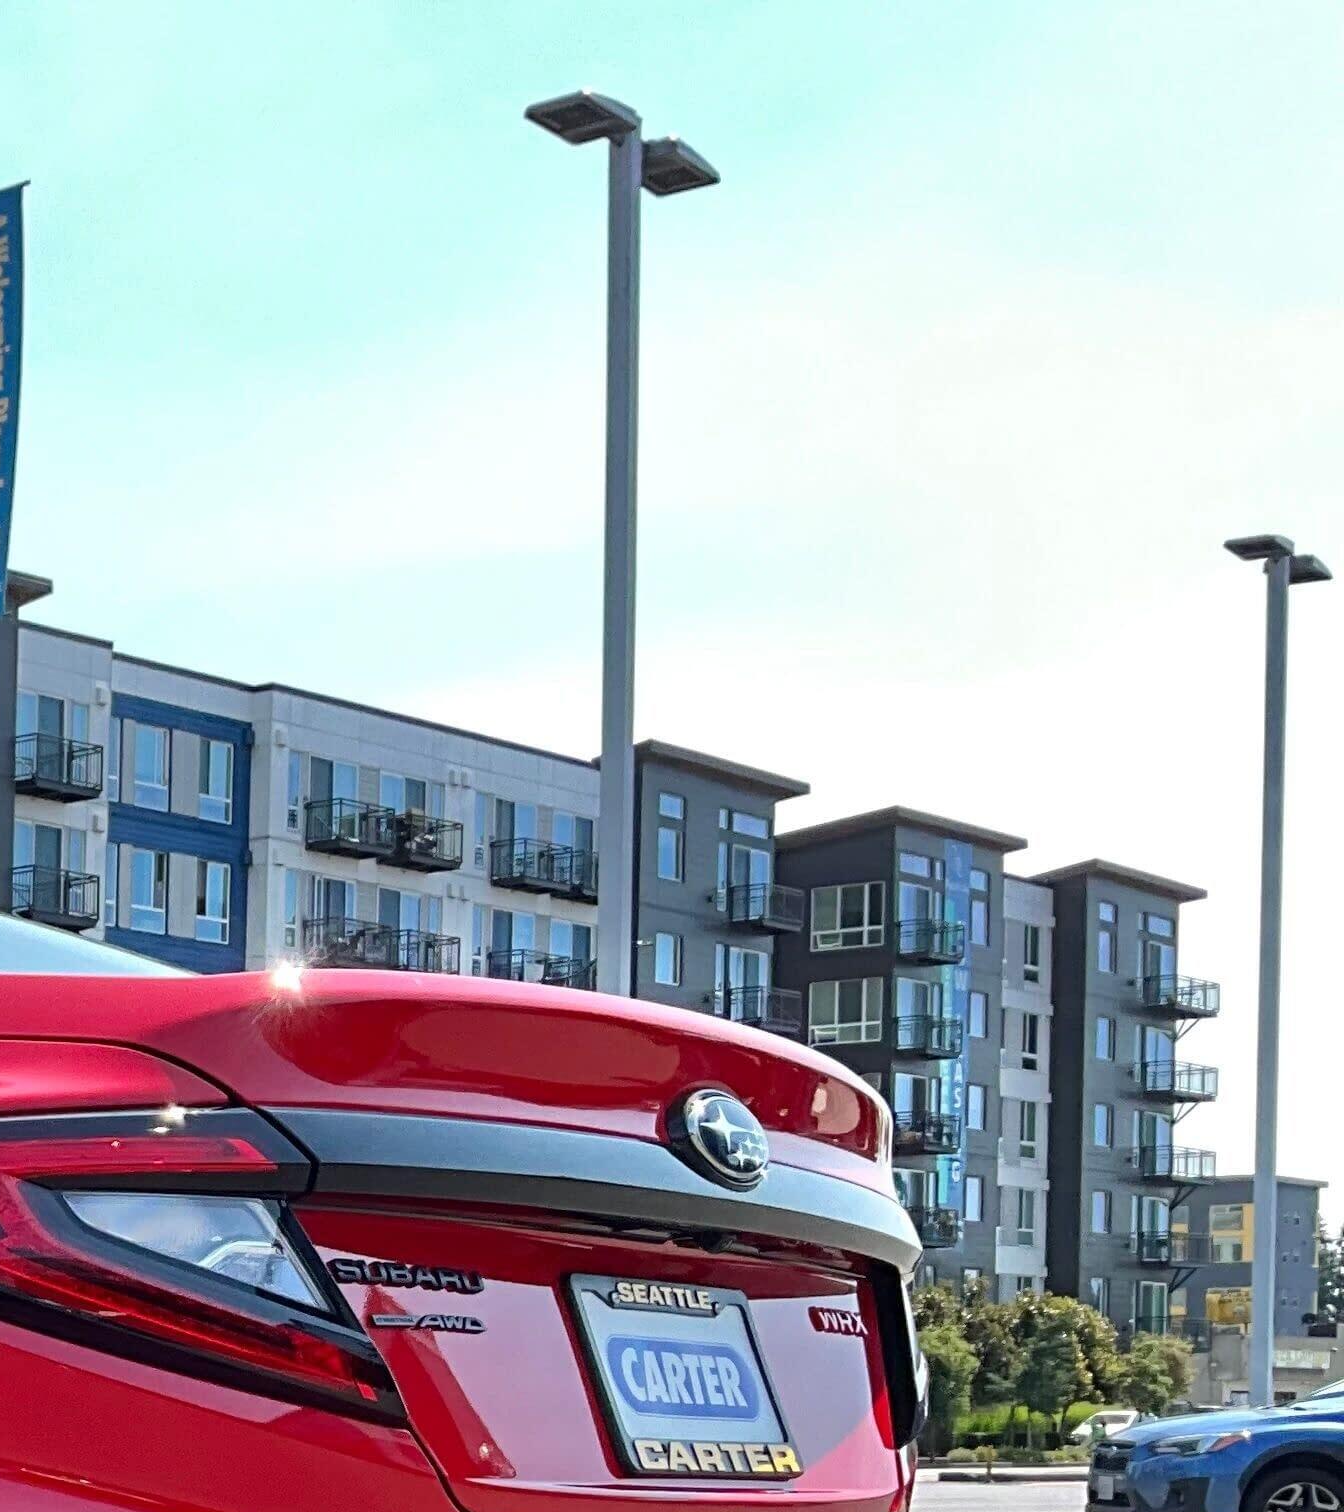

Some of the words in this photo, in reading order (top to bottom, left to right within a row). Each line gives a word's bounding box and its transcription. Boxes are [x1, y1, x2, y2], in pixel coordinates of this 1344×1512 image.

[329, 1258, 485, 1294] SUBARU
[615, 1281, 712, 1310] SEATTLE
[416, 1313, 487, 1334] AWD
[818, 1311, 868, 1335] WRX
[621, 1347, 748, 1408] CARTER
[633, 1439, 802, 1473] CARTER
